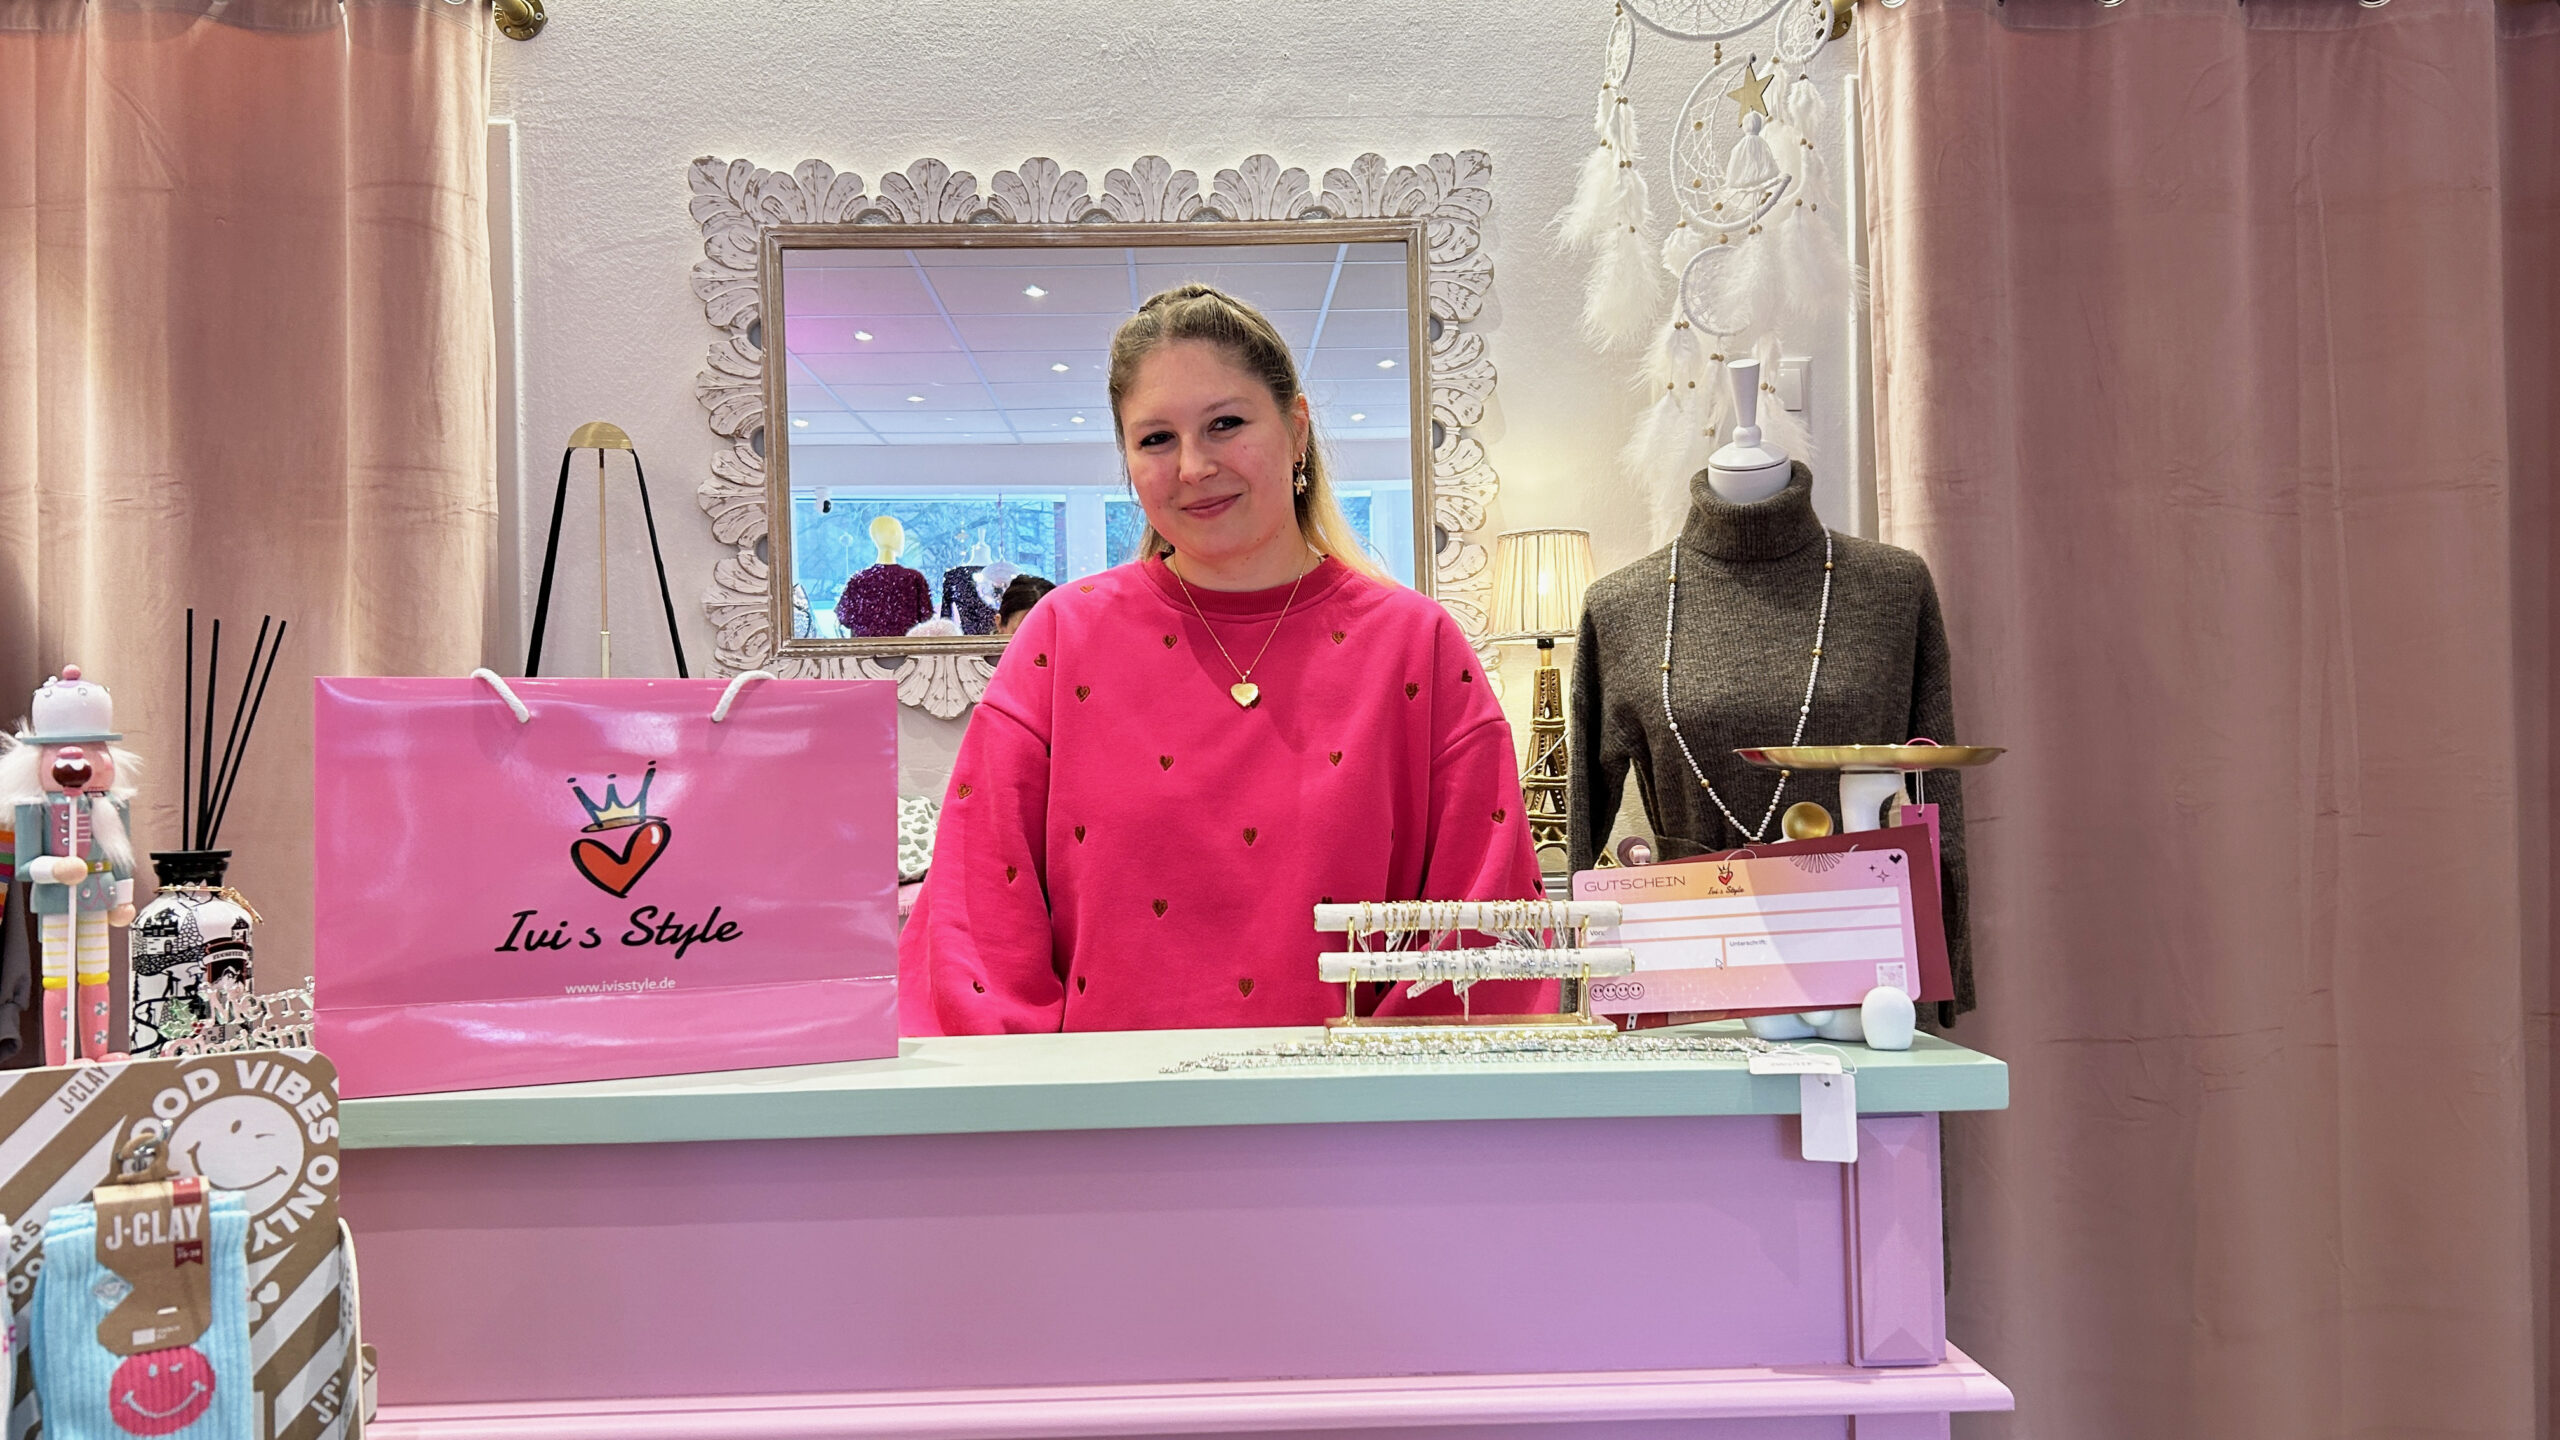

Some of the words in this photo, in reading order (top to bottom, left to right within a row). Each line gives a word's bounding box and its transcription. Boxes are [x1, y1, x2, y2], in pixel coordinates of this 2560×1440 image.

[1584, 876, 1686, 892] GUTSCHEIN
[620, 905, 744, 960] Style
[565, 977, 676, 994] www.ivisstyle.de
[130, 1068, 220, 1142] OOD
[234, 1059, 340, 1144] VIBES
[252, 1155, 339, 1254] ONLY
